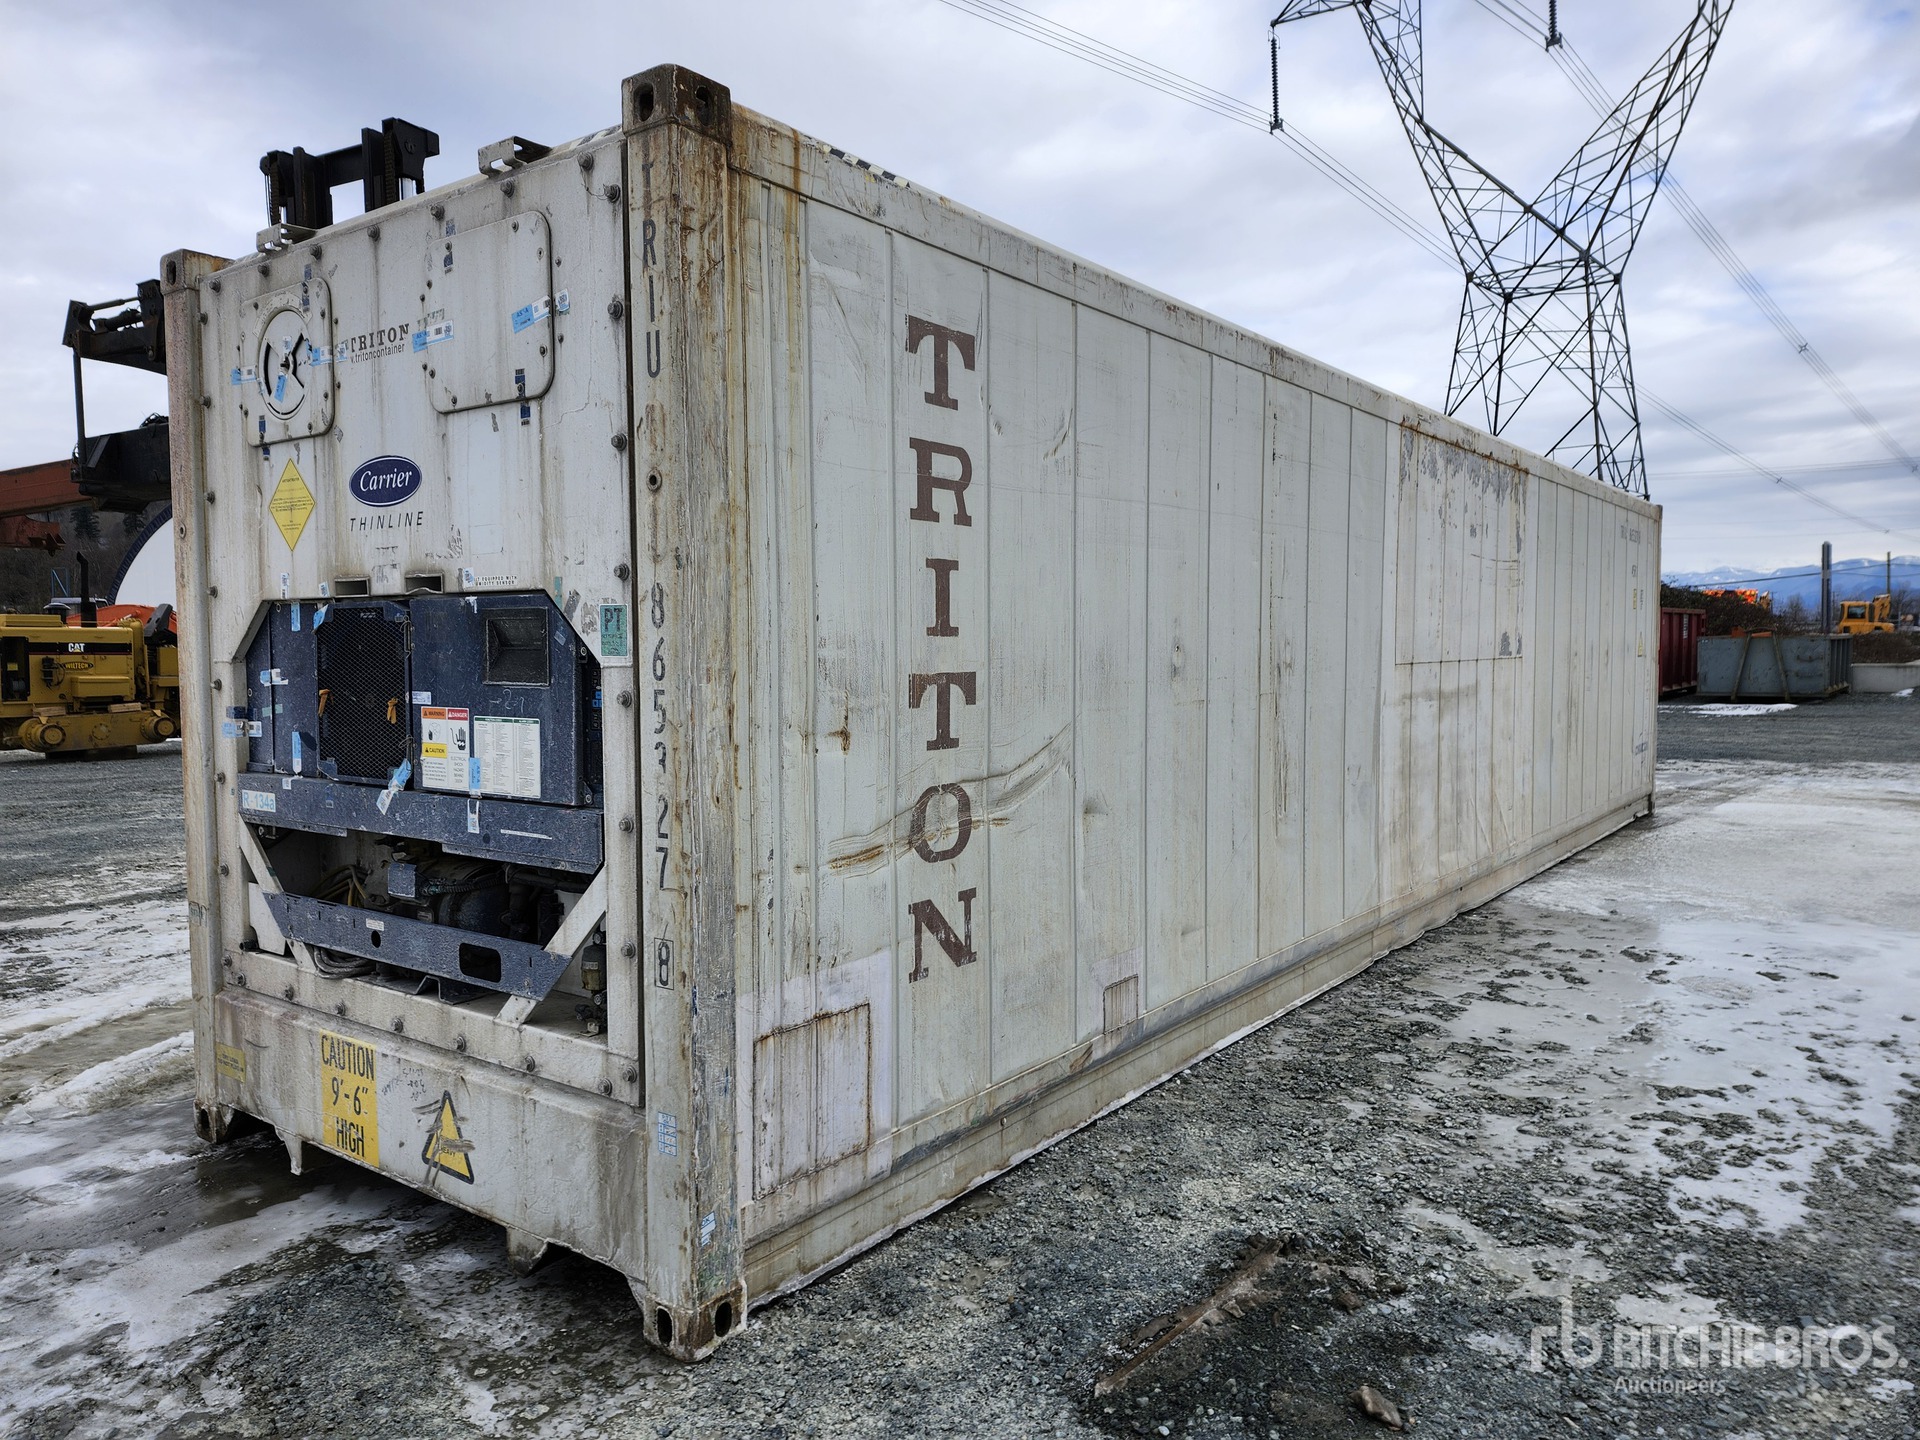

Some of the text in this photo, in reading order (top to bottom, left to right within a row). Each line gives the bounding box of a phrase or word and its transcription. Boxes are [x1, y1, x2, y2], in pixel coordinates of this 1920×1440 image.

[641, 163, 661, 378] TRIU
[350, 323, 409, 353] TRITON
[360, 468, 412, 492] Carrier
[350, 511, 423, 532] THINLINE
[68, 642, 85, 653] CAT
[905, 313, 977, 984] TRITON
[243, 791, 275, 810] R-134a
[321, 1034, 375, 1082] CAUTION
[336, 1117, 365, 1157] HIGH
